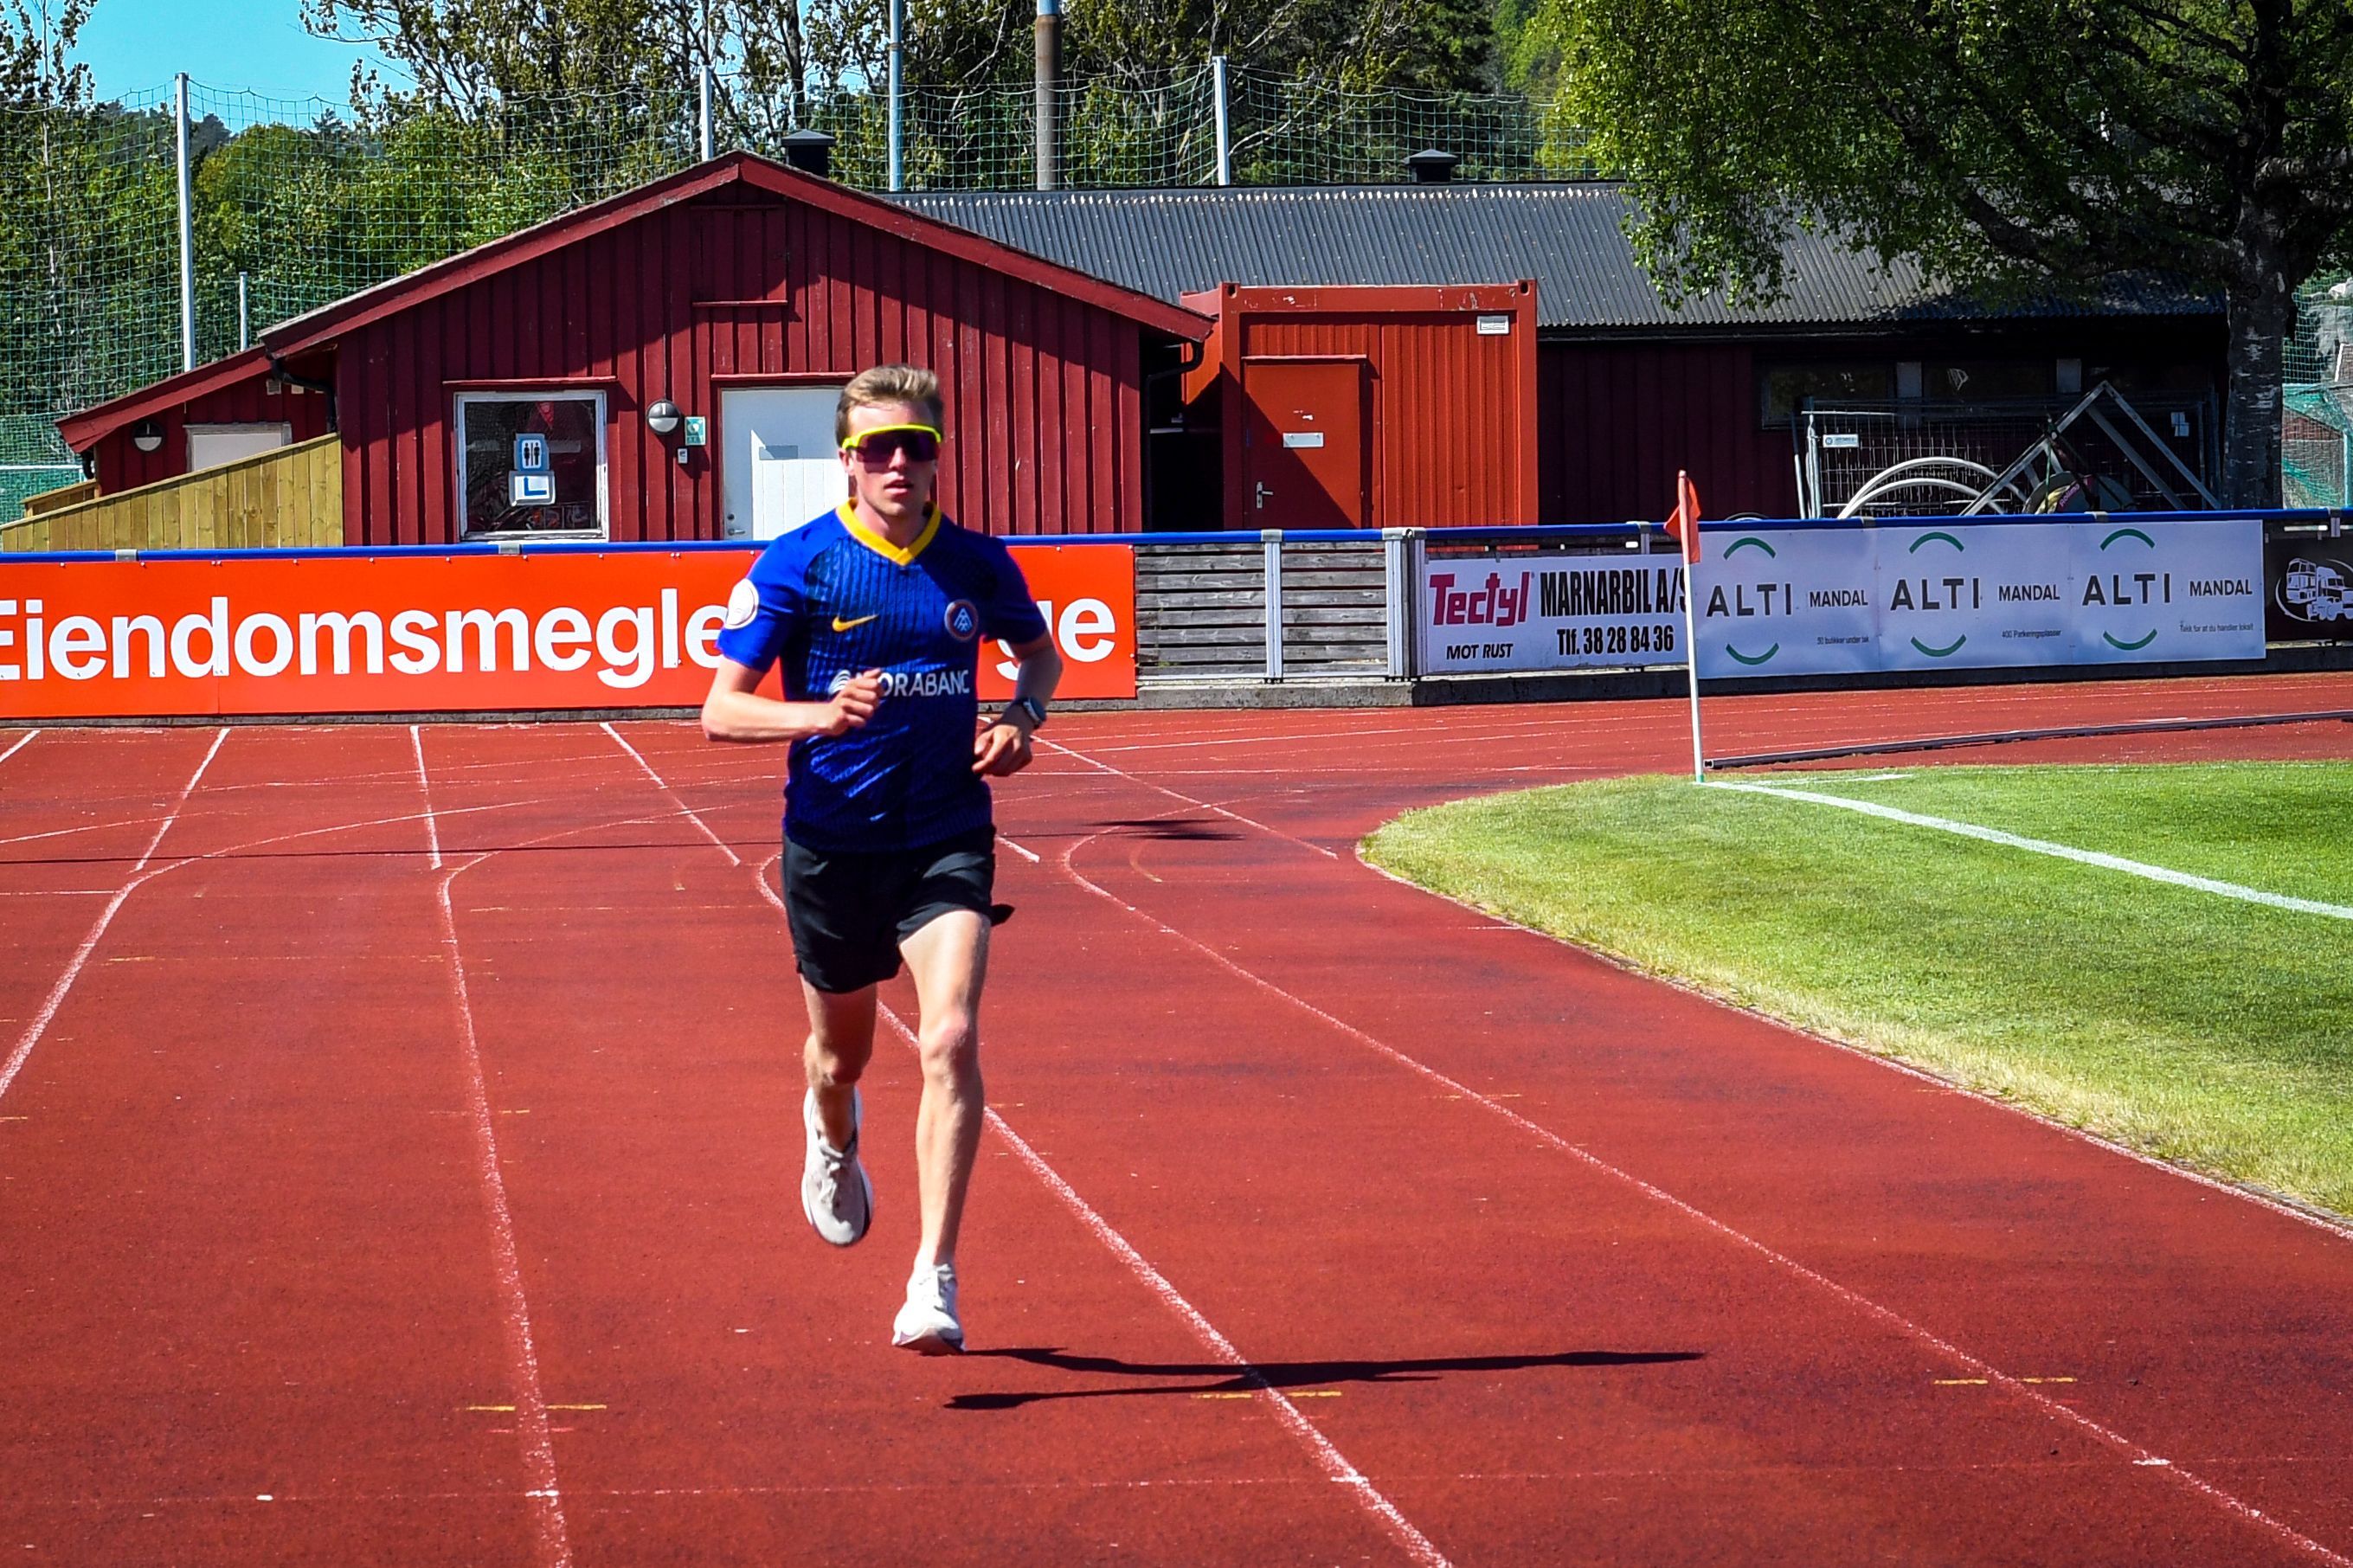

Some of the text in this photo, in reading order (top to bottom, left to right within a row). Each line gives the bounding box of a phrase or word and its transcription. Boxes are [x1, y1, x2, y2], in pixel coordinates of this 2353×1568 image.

[1430, 571, 1530, 627] Tectyl
[1540, 569, 1652, 617] MARNARBIL
[1706, 583, 1791, 617] ALTI
[1810, 589, 1868, 607] MANDAL
[1890, 577, 1979, 610] ALTI
[1998, 584, 2060, 601] MANDAL
[2082, 573, 2170, 606] ALTI
[2189, 579, 2253, 596] MANDAL
[1446, 643, 1514, 659] MOT RUST
[1557, 625, 1674, 655] Tlf. 38 28 84 36
[856, 670, 970, 697] ORABANC
